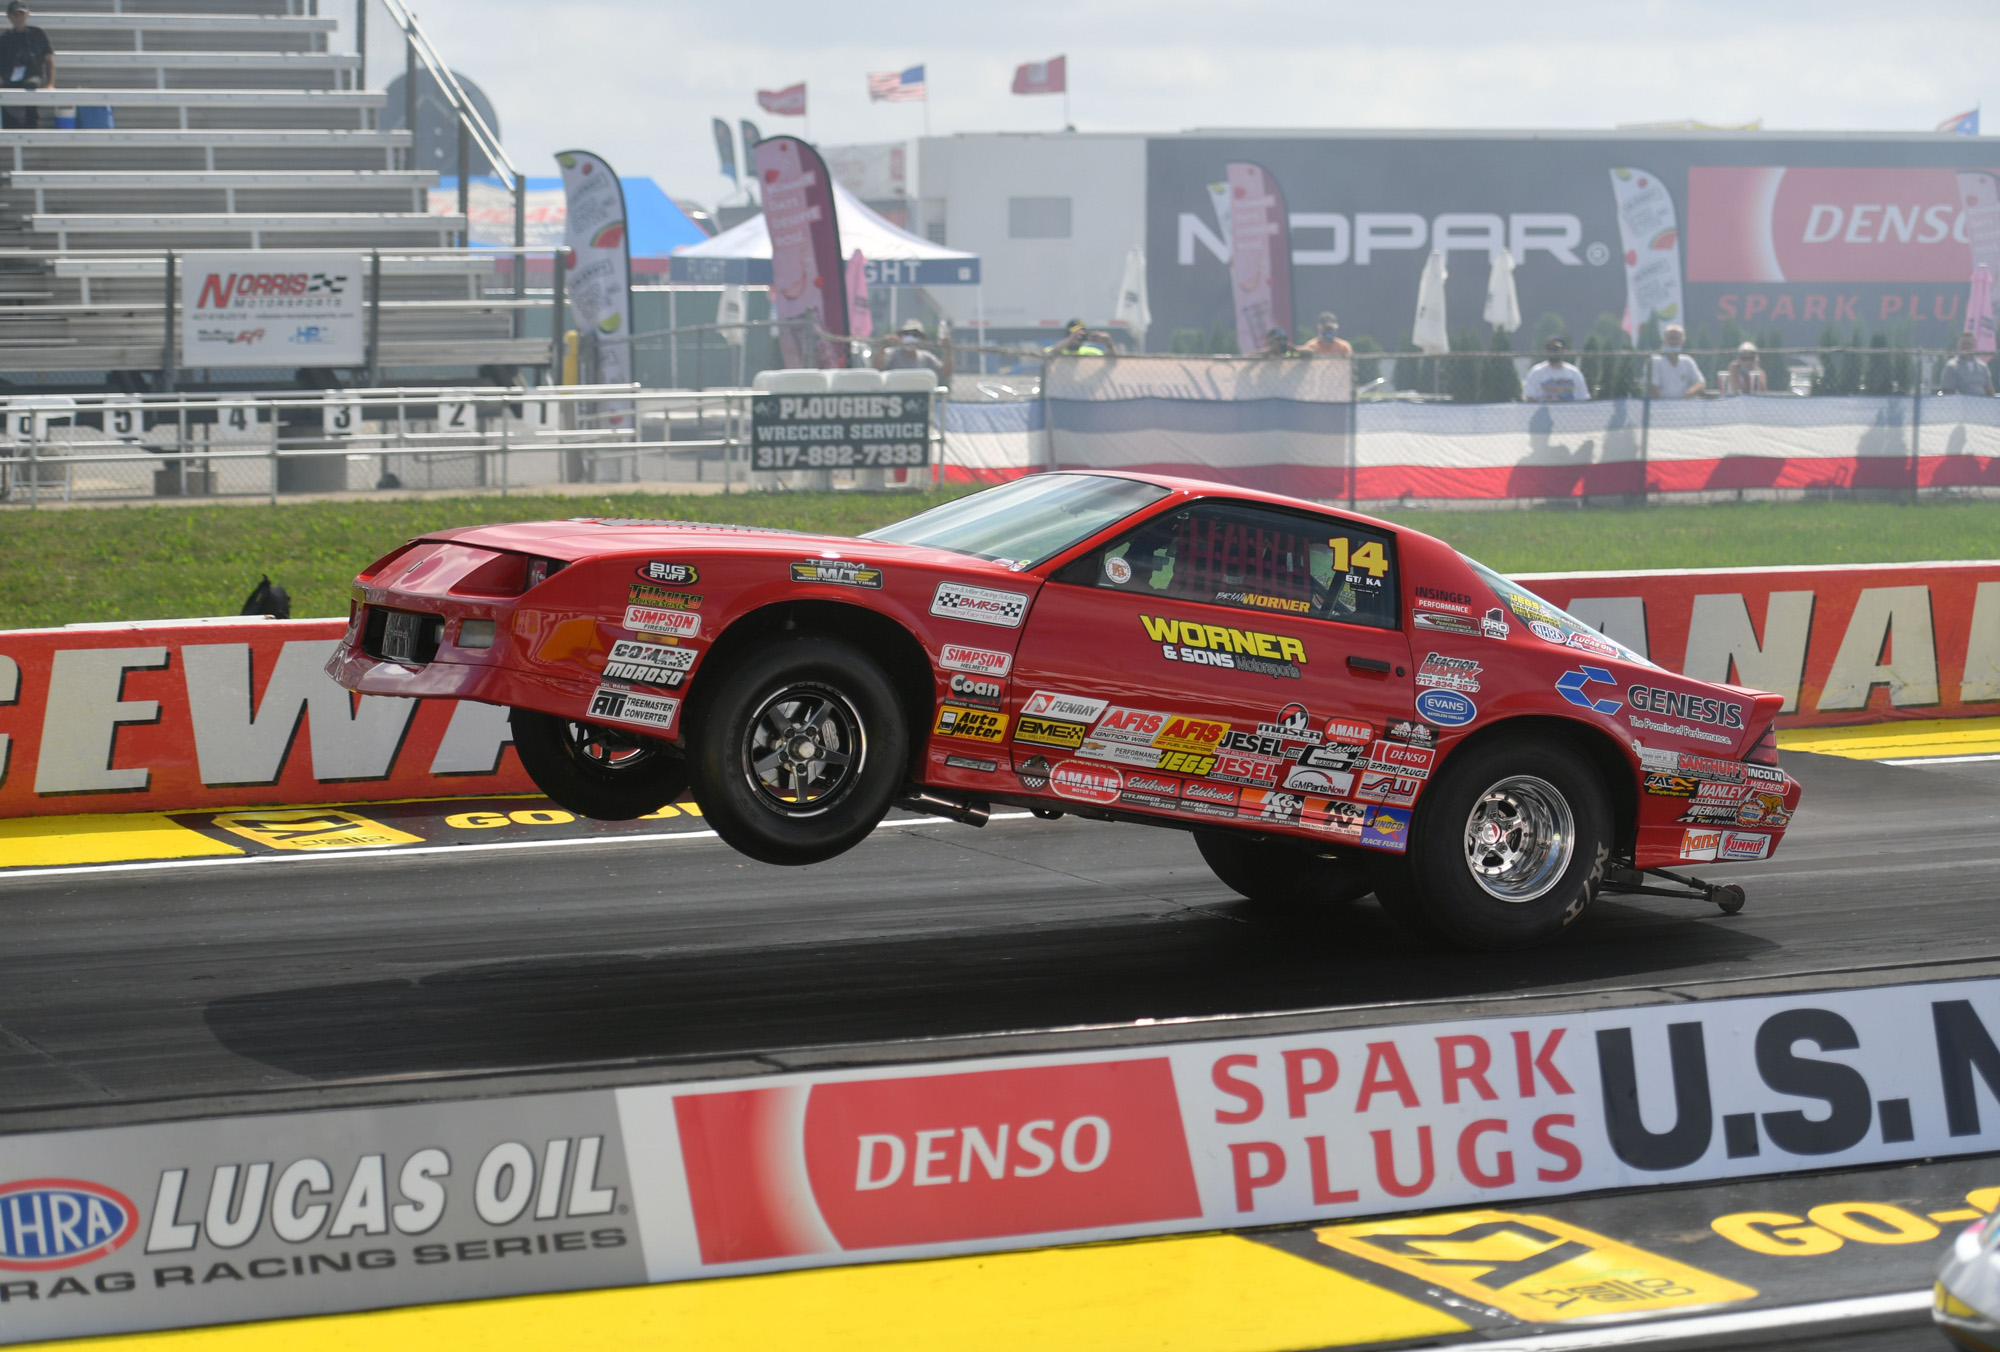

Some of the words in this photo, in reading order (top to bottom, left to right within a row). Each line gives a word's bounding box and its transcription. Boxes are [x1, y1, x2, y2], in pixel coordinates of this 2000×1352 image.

[865, 262, 921, 283] GHT
[197, 274, 308, 308] NORRIS
[234, 298, 342, 308] MOTORSPORTS
[1716, 295, 1859, 321] SPARK
[333, 401, 352, 429] 3
[449, 401, 466, 428] 2
[779, 396, 903, 420] PLOUGHE'S
[113, 406, 132, 433] 5
[229, 405, 247, 431] 4
[757, 424, 844, 441] WRECKER
[849, 422, 925, 440] SERVICE
[757, 443, 923, 467] 317-892-7333
[805, 558, 867, 570] TEAM
[1329, 537, 1389, 577] 14
[650, 562, 686, 575] BIG
[650, 571, 685, 581] STUFF
[817, 567, 860, 581] M/T
[1366, 578, 1381, 587] KA
[629, 583, 704, 609] Tilburg
[1242, 593, 1311, 613] WORNER
[1415, 586, 1472, 605] INSINGER
[958, 597, 1000, 612] BMRS
[1418, 599, 1469, 613] PERFORMANCE
[630, 609, 695, 629] SIMPSON
[1483, 619, 1508, 633] PRO
[643, 623, 678, 633] FIRESUITS
[1534, 624, 1562, 639] NHRA
[1139, 614, 1308, 663] WORNER
[1574, 635, 1600, 648] LUCAS
[1601, 642, 1614, 652] OIL
[613, 643, 676, 661] COMP
[946, 648, 1006, 668] SIMPSON
[654, 659, 685, 668] CAMS
[960, 662, 988, 671] HELMETS
[1164, 645, 1177, 660] &
[1181, 648, 1235, 668] SONS
[1235, 655, 1301, 679] Motorsports
[1426, 653, 1477, 670] REACTION
[602, 661, 685, 686] MOROSO
[1421, 663, 1480, 680] GRAFFIX
[951, 674, 1000, 697] Coan
[1416, 678, 1479, 691] 717-834-3577
[627, 696, 674, 713] TREEMASTER
[1051, 701, 1098, 716] PENRAY
[1428, 698, 1464, 711] EVANS
[1628, 684, 1742, 729] GENESIS
[624, 708, 668, 724] CONVERTER
[959, 712, 998, 726] Auto
[1101, 710, 1163, 733] AFIS
[952, 722, 1001, 739] Meter
[1019, 720, 1071, 739] BME
[1163, 719, 1223, 743] AFIS
[1328, 724, 1371, 740] AMALIE
[1629, 715, 1644, 728] The
[1645, 718, 1675, 734] Promise
[1675, 725, 1684, 735] of
[1094, 731, 1129, 741] IGNITION
[1131, 736, 1151, 744] WIRE
[1218, 731, 1284, 757] JESEL
[1115, 747, 1160, 760] PERFORMANCE
[1324, 742, 1365, 756] Racing
[1389, 749, 1427, 764] DENSO
[1157, 751, 1217, 776] JEGS
[1211, 757, 1277, 782] JESEL
[1315, 760, 1340, 768] GASKET
[1369, 762, 1399, 773] SPARK
[1400, 766, 1428, 778] PLUGS
[1642, 764, 1679, 775] RACING
[1679, 754, 1748, 779] SANTHUFF'S
[1055, 770, 1118, 793] AMALIE
[1644, 775, 1674, 787] PAC
[1748, 767, 1782, 782] INCOLN
[1072, 787, 1089, 795] MOTOR
[1127, 776, 1175, 794] Edelbrock
[1186, 784, 1234, 802] Edelbrock
[1697, 783, 1747, 798] MANLEY
[1751, 780, 1784, 792] WELDERS
[1122, 792, 1160, 802] CYLINDER
[1149, 801, 1176, 810] HEADS
[1181, 800, 1210, 808] INTAKE
[1194, 807, 1234, 817] MANIFOLD
[1367, 818, 1404, 831] SUNOCO
[1362, 838, 1382, 846] RACE
[1382, 840, 1404, 849] FUELS
[1682, 830, 1720, 857] hans
[1211, 1026, 1576, 1125] SPARK
[1595, 1007, 1914, 1172] U.S.
[855, 1115, 1112, 1191] DENSO
[1226, 1112, 1584, 1214] PLUGS
[143, 1148, 452, 1256] LUCAS
[474, 1134, 617, 1225] OIL
[0, 1193, 113, 1259] HRA
[154, 1247, 396, 1289] RACING
[412, 1226, 628, 1266] SERIES
